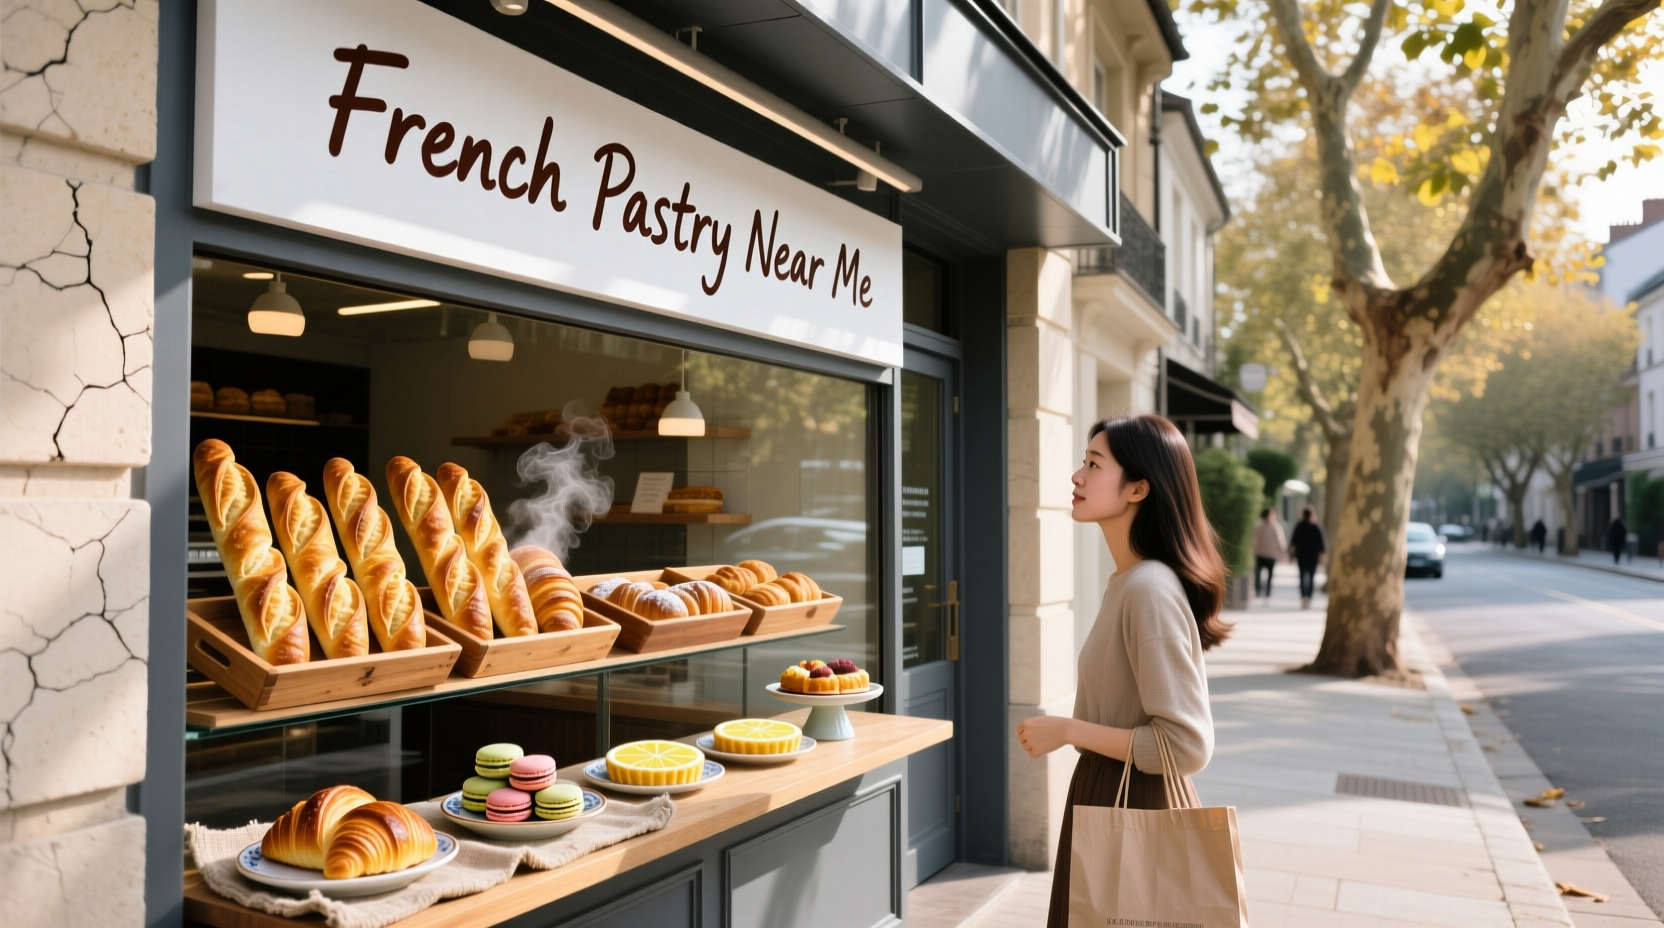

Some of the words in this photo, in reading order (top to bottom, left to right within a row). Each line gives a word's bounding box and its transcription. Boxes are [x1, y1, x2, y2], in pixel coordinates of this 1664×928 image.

[328, 44, 567, 213] French
[592, 142, 732, 296] Pastry
[745, 209, 825, 290] Near
[831, 243, 873, 308] Me
